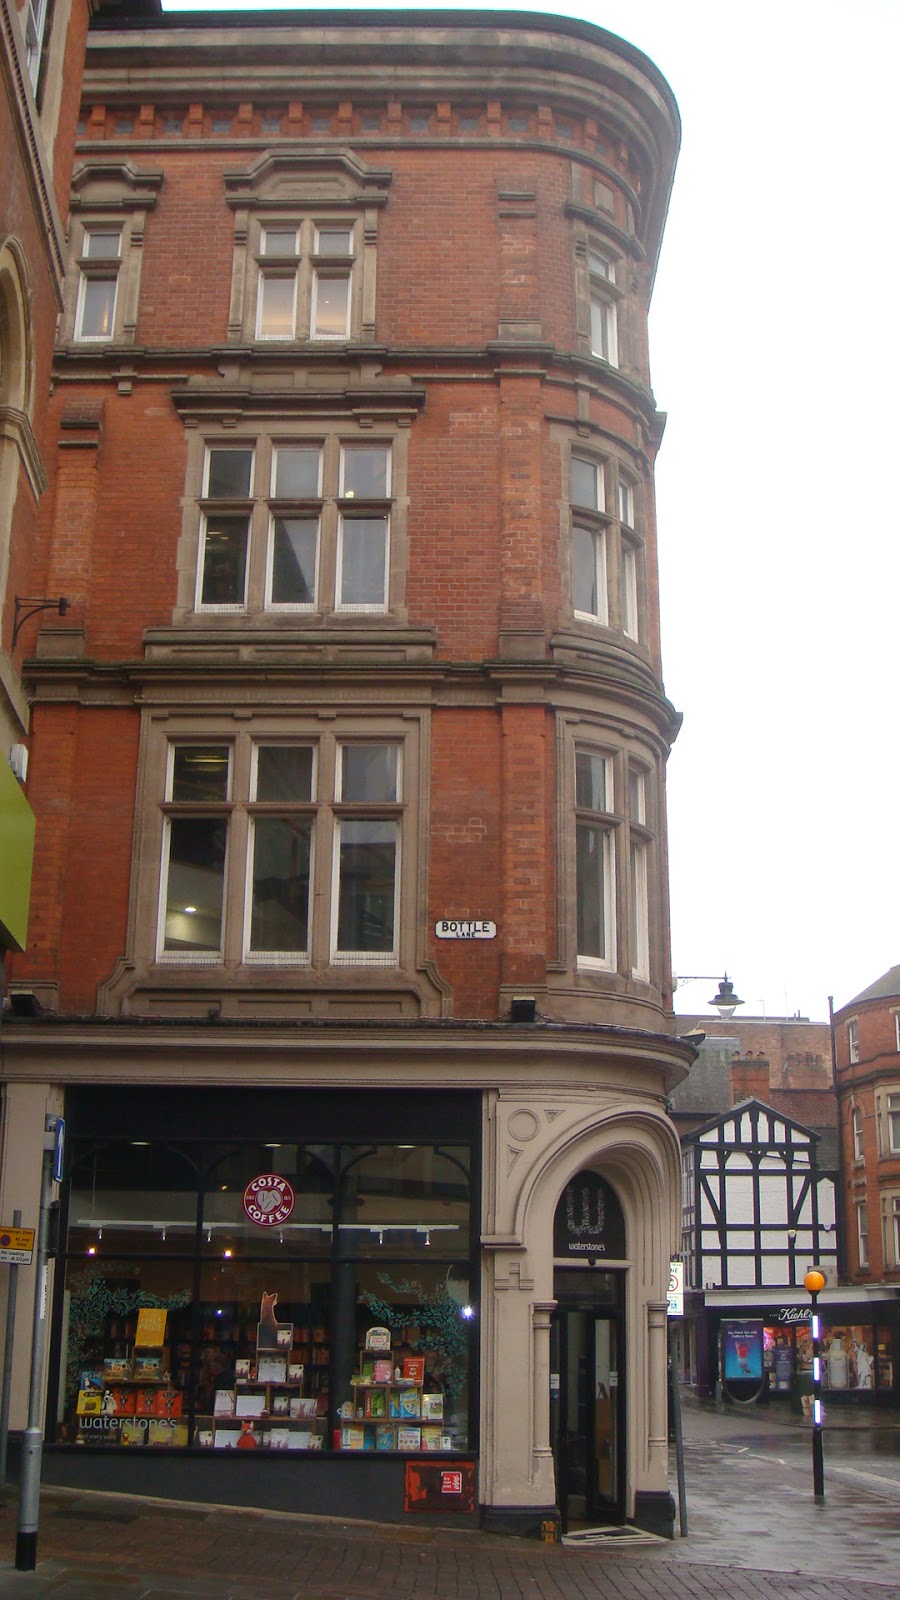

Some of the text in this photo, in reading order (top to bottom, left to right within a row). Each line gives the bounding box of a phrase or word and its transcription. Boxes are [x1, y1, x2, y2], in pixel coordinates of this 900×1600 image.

[442, 921, 490, 932] BOTTLE
[251, 1177, 286, 1192] COSTA
[248, 1204, 290, 1223] COFFEE
[568, 1242, 606, 1252] waterstone's
[778, 1308, 813, 1321] Kiehl's
[79, 1415, 177, 1430] waterstone's
